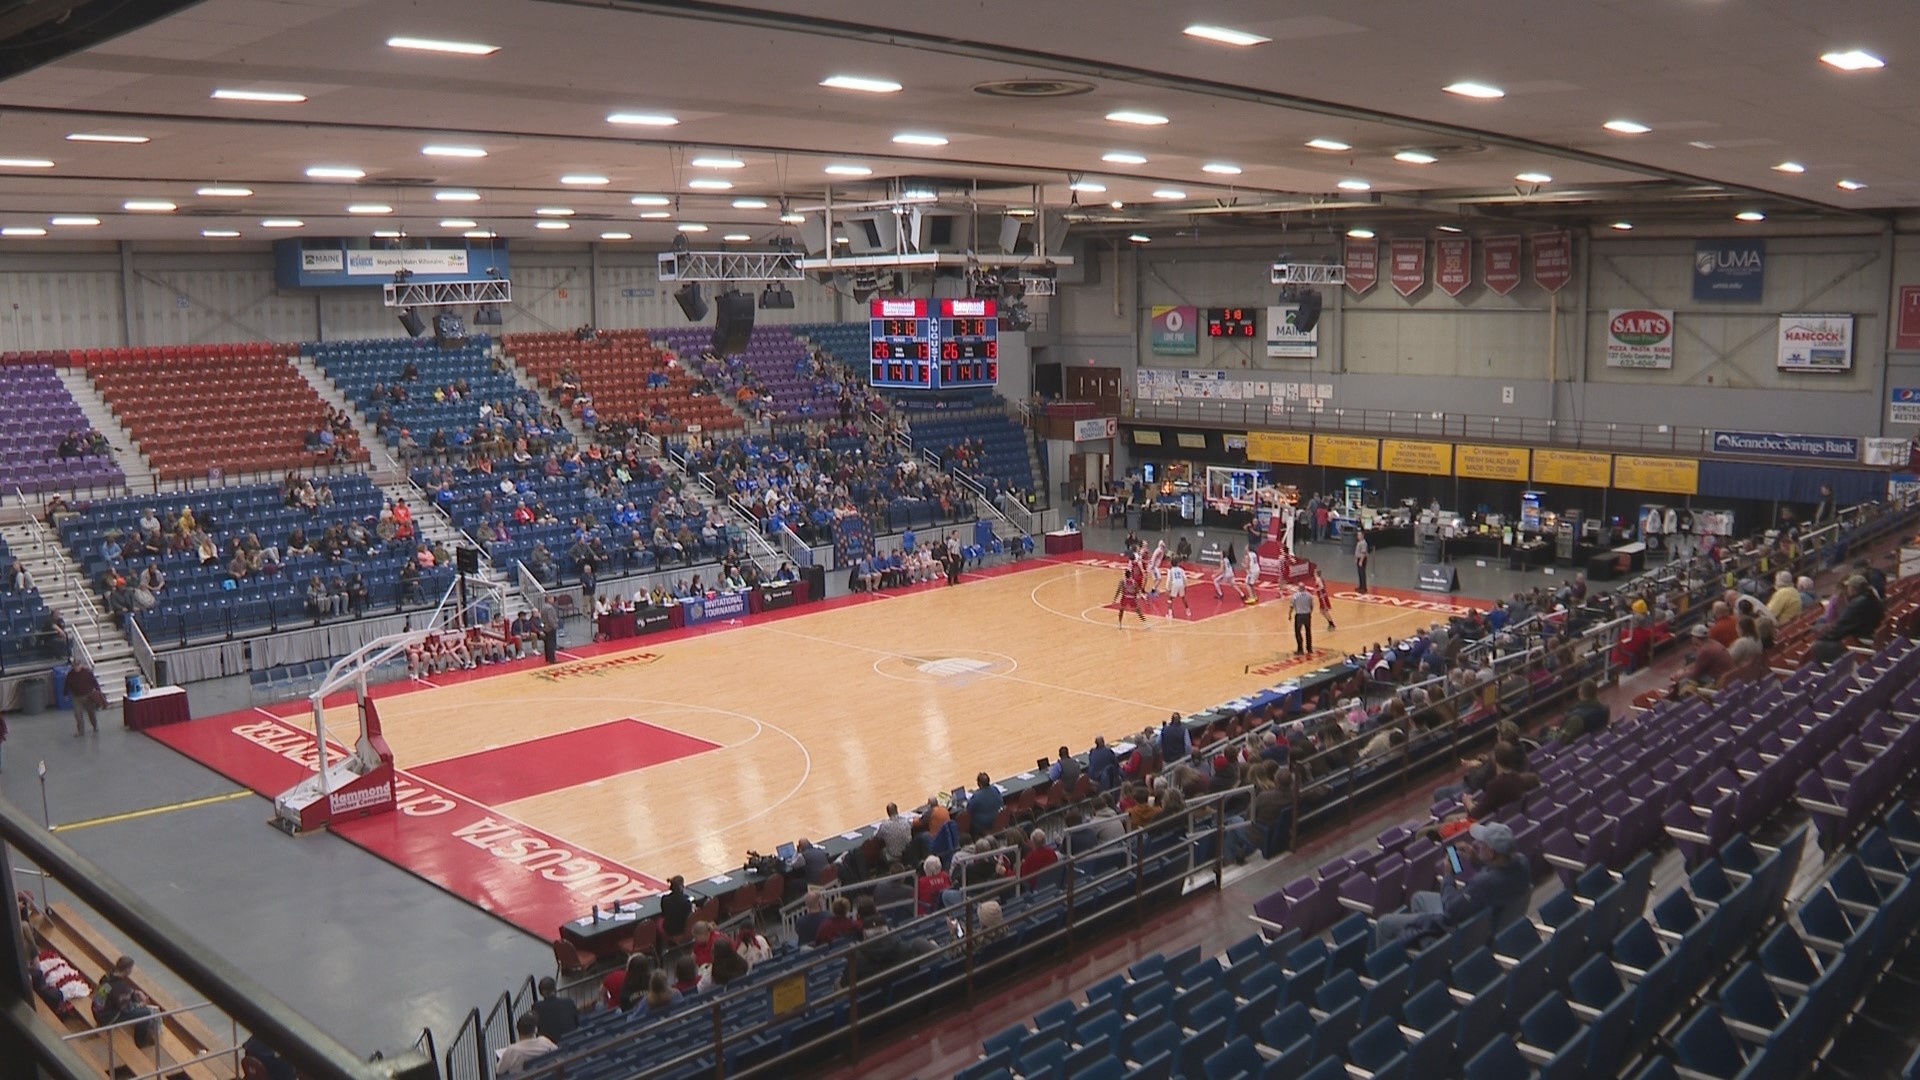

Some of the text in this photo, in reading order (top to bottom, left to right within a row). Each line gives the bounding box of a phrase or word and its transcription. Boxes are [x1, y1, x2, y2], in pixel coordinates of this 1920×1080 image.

[316, 255, 340, 263] MAINE
[1718, 251, 1761, 267] UMA
[1211, 326, 1222, 336] 26
[1244, 326, 1252, 336] 13
[1613, 318, 1666, 334] SAM'S
[1164, 333, 1184, 342] LONE PINE
[1786, 332, 1840, 341] HANCOCK
[874, 343, 888, 358] 26
[918, 343, 928, 358] 13
[943, 343, 958, 358] 26
[986, 342, 996, 358] 13
[1730, 436, 1784, 450] Kennebec
[1785, 439, 1825, 454] Savings
[1826, 442, 1854, 454] Bank
[1464, 456, 1484, 464] FRESH
[1466, 464, 1482, 472] MADE
[704, 595, 743, 608] INVITATIONAL
[704, 603, 744, 618] TOURNAMENT
[232, 720, 348, 772] ENTER
[330, 782, 391, 804] Hammond
[332, 794, 390, 813] Lumber Company
[452, 816, 662, 904] AUGUSTA
